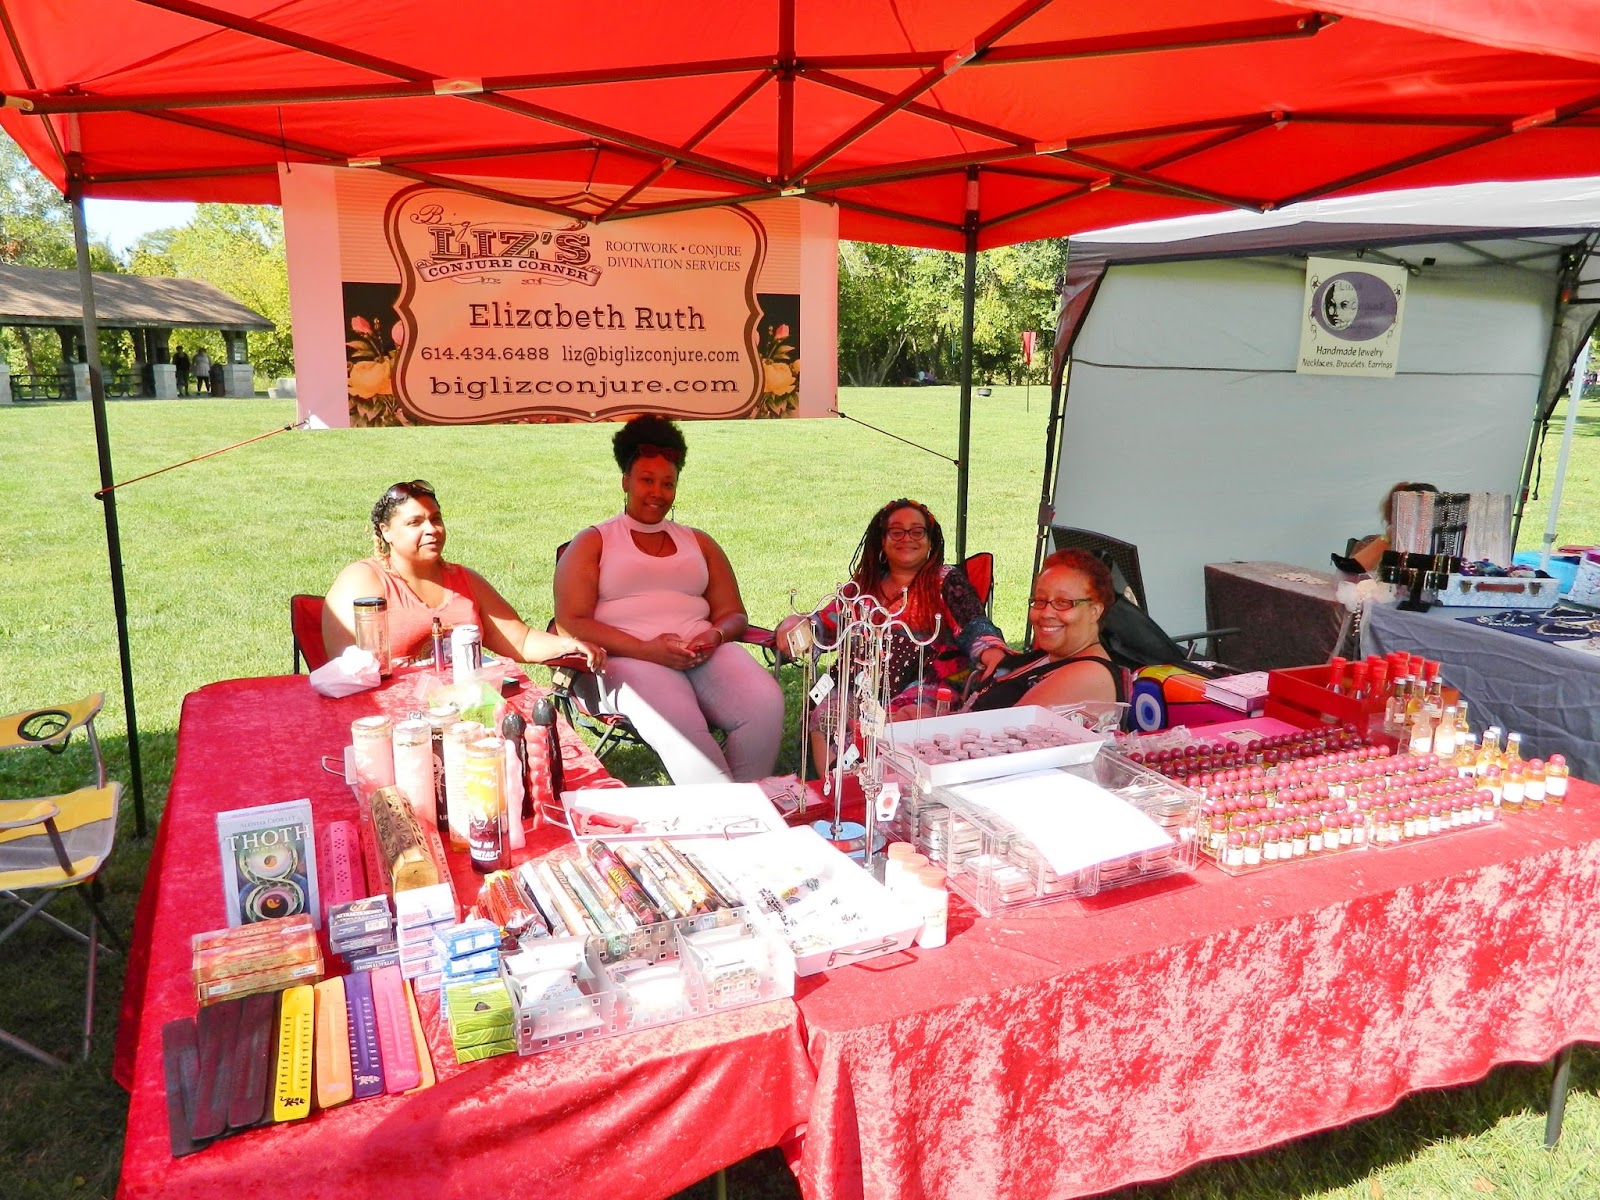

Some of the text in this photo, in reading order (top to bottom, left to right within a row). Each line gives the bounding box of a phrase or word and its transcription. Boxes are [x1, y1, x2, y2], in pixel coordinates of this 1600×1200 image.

[410, 204, 471, 242] Big
[428, 226, 592, 265] LIZ'S
[605, 240, 741, 258] ROOTWORK CONJURE
[428, 259, 589, 281] CONJURE CORNER
[607, 257, 741, 272] DIVINATION SERVICES
[469, 302, 706, 331] Elizabeth Ruth
[421, 345, 740, 367] 614.434.6488 liz@biglizconjure.com
[1316, 345, 1384, 358] Handmade Jewelry
[1367, 360, 1393, 370] Earrings
[430, 376, 740, 401] biglizconjure.com
[225, 823, 311, 852] THOTH
